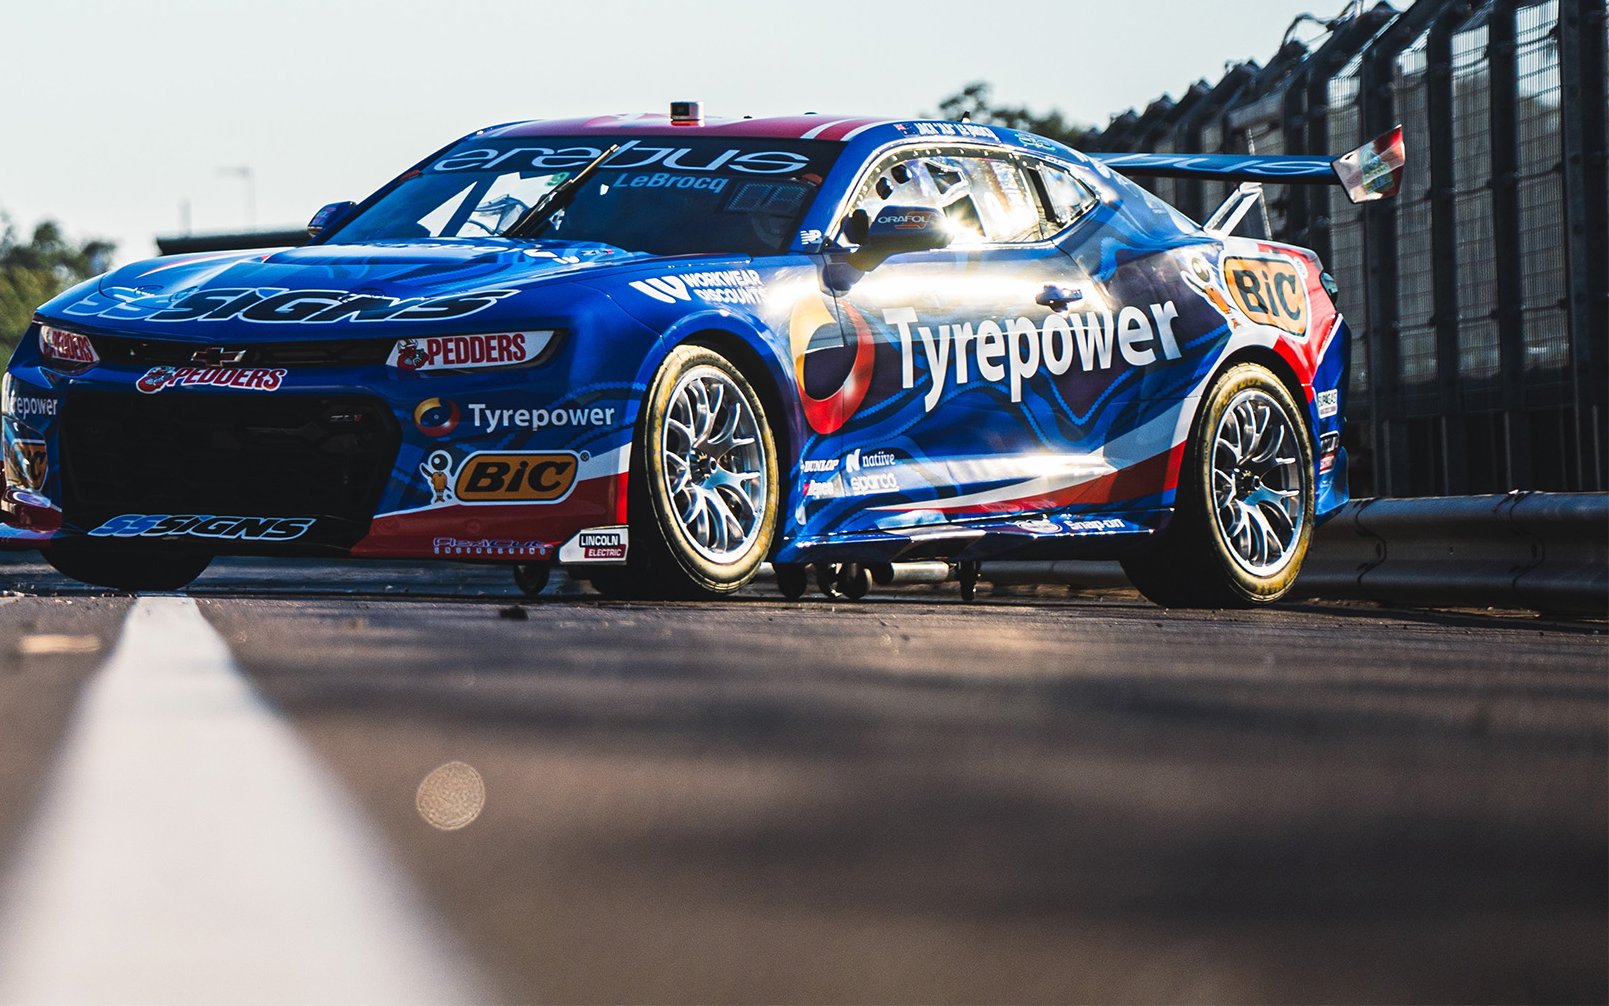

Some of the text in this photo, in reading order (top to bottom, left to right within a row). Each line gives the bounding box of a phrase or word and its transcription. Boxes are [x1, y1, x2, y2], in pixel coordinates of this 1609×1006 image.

[434, 140, 810, 173] erebus
[546, 172, 570, 187] 9
[612, 173, 729, 194] LeBrocq
[877, 214, 928, 224] ORAFOL
[678, 269, 764, 288] WORKWEAR
[692, 287, 768, 305] DISCOUNTS
[426, 333, 527, 366] PEDDERS
[882, 300, 1183, 413] Tyrepower
[169, 367, 286, 391] PEDDERS
[468, 403, 615, 433] Tyrepower
[803, 459, 839, 472] DUNLOP
[862, 451, 896, 467] natiive
[580, 535, 619, 546] LINCOLN
[588, 548, 622, 557] ELECTRIC
